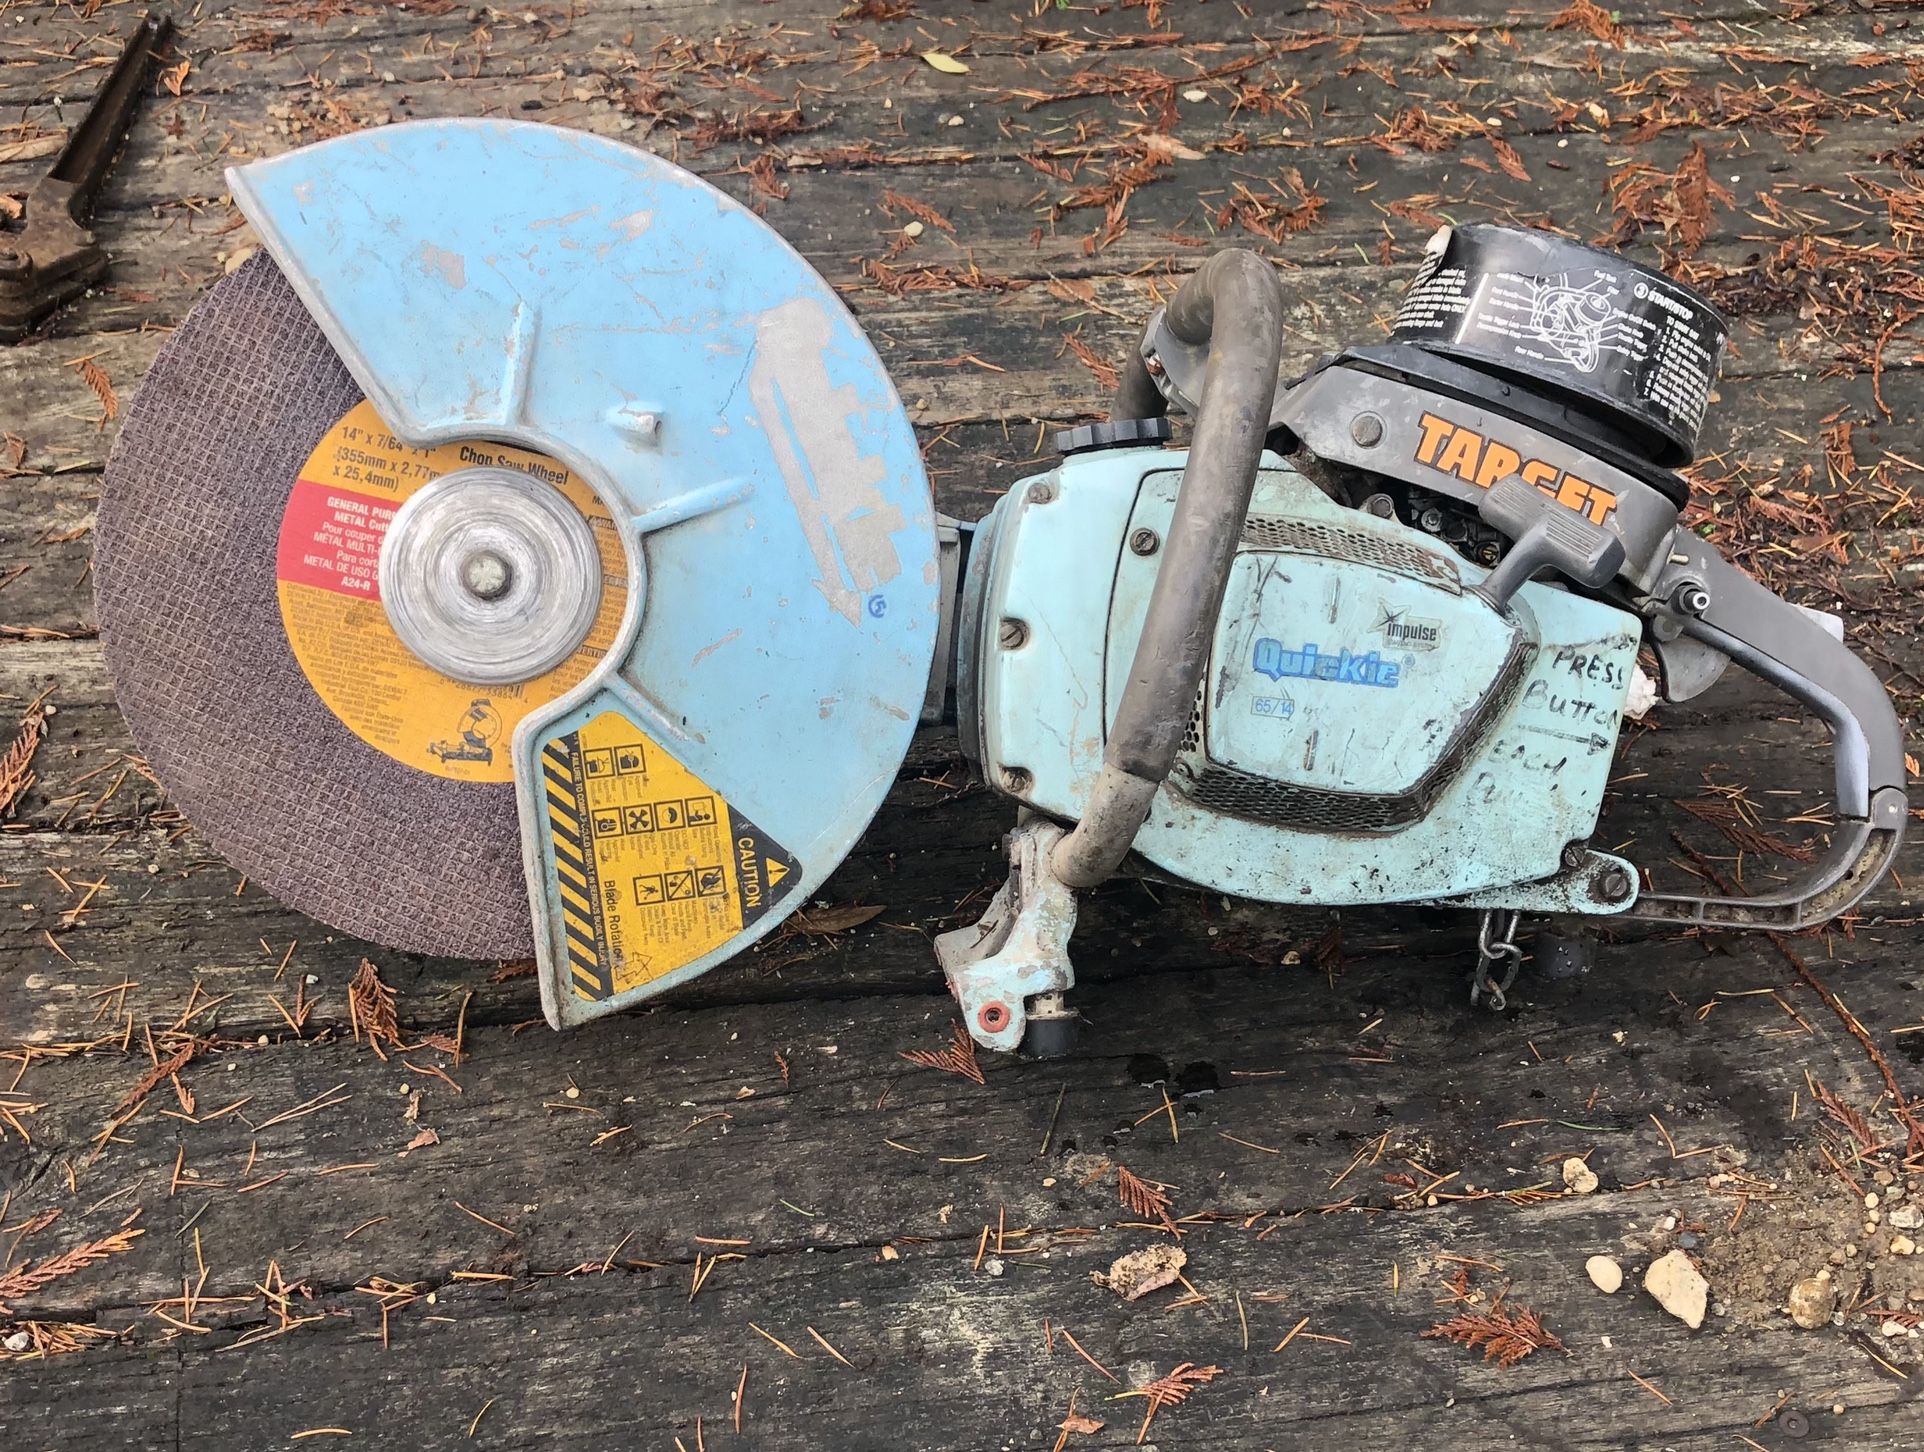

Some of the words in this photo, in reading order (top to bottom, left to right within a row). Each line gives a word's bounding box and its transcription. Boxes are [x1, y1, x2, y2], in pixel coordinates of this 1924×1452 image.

[1646, 289, 1695, 322] START/STOP
[342, 425, 364, 440] 14"
[366, 432, 372, 446] x
[332, 464, 340, 477] x
[344, 465, 400, 493] 25,4mm)
[390, 461, 397, 473] x
[528, 461, 570, 486] Wheel
[1413, 409, 1617, 527] TARGET
[326, 496, 370, 516] GENERAL
[334, 510, 367, 528] METAL
[322, 521, 343, 535] Pour
[344, 528, 377, 543] couper
[303, 554, 335, 571] METAL
[336, 562, 350, 574] DE
[350, 565, 371, 579] USO
[336, 549, 357, 564] Para
[340, 575, 372, 592] A24-R
[1252, 637, 1401, 689] Quickie
[1551, 648, 1624, 690] PRESS
[1255, 698, 1294, 715] 65/14
[570, 751, 582, 782] FAILURE
[575, 782, 584, 793] TO
[584, 848, 595, 875] RESULT
[737, 836, 763, 908] CAUTION
[589, 884, 601, 914] SERIOUS
[603, 879, 620, 912] Blade
[607, 914, 627, 963] Rotation
